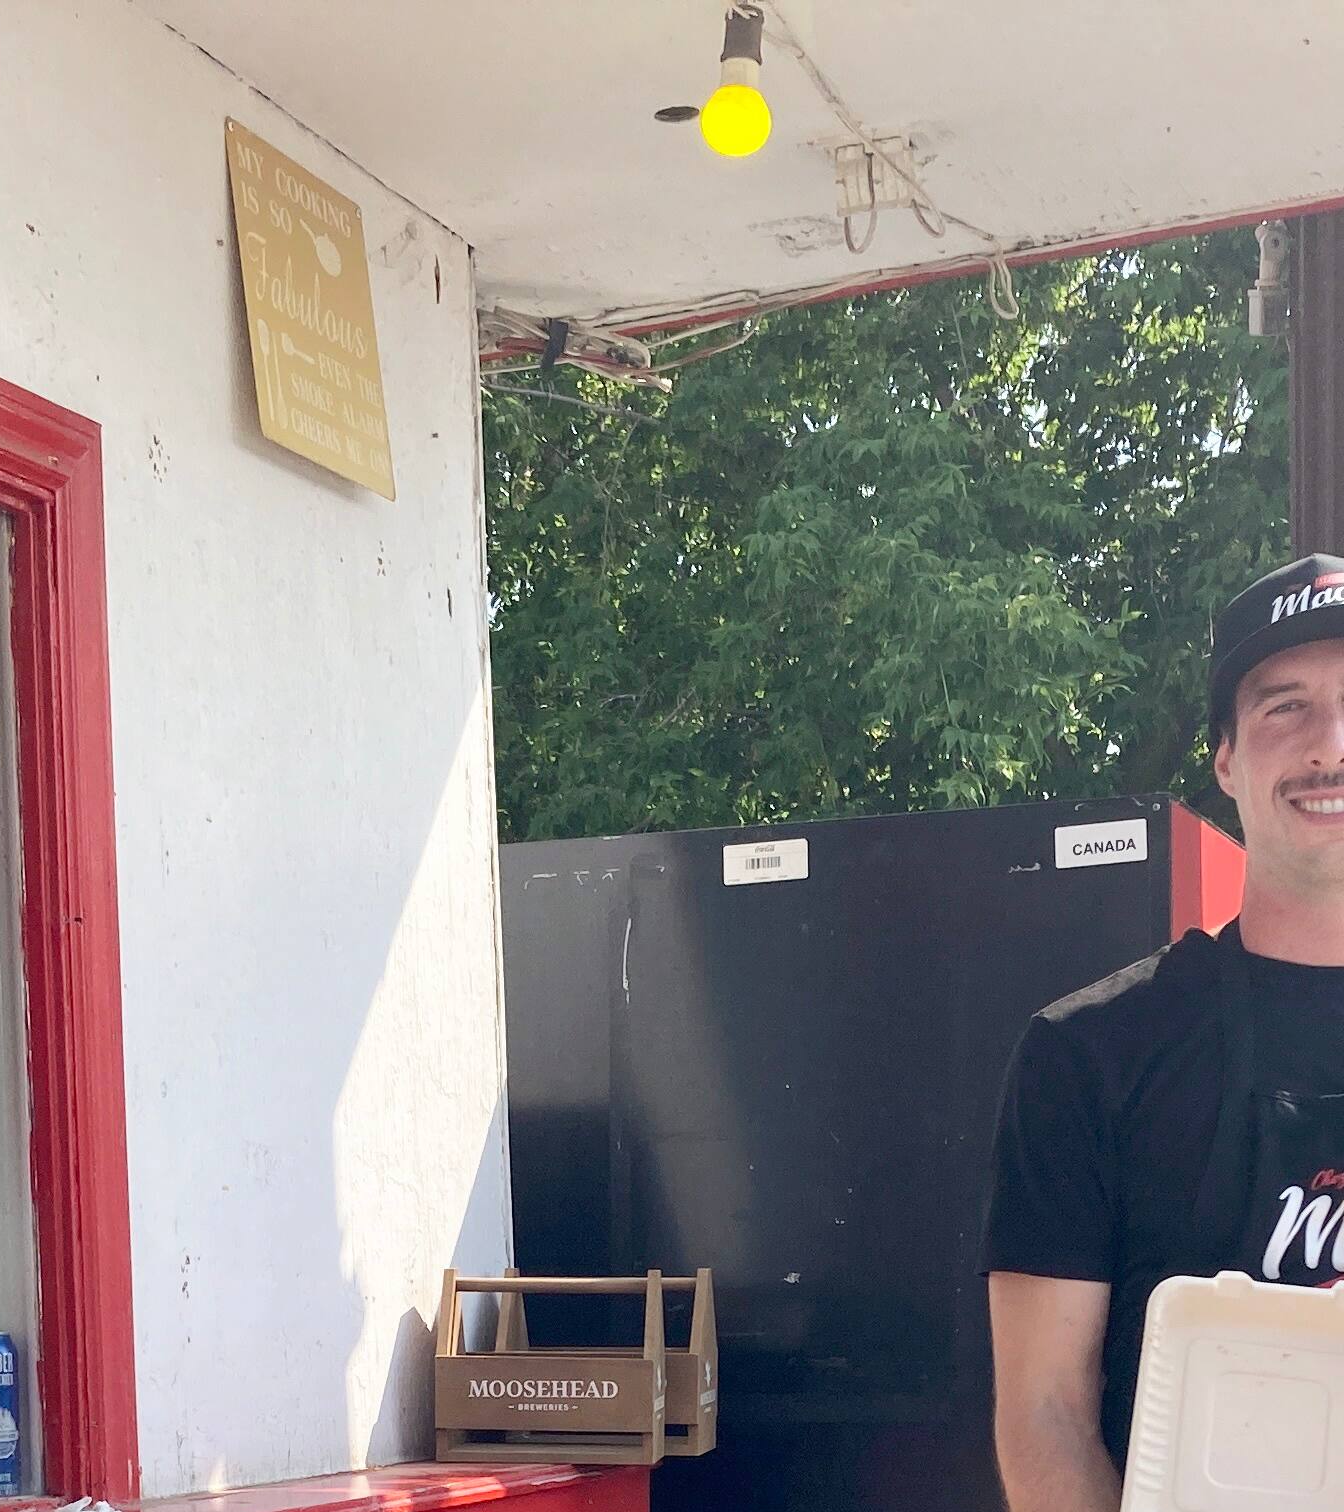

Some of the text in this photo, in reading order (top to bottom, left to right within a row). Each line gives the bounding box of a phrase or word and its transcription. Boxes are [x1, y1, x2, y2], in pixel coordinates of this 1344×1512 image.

[236, 142, 352, 238] MY COOKING
[241, 181, 293, 235] IS SO
[247, 231, 369, 360] Fabulous
[1072, 838, 1137, 856] CANADA
[467, 1379, 619, 1399] MOOSEHEAD
[517, 1402, 570, 1412] BREWERIES
